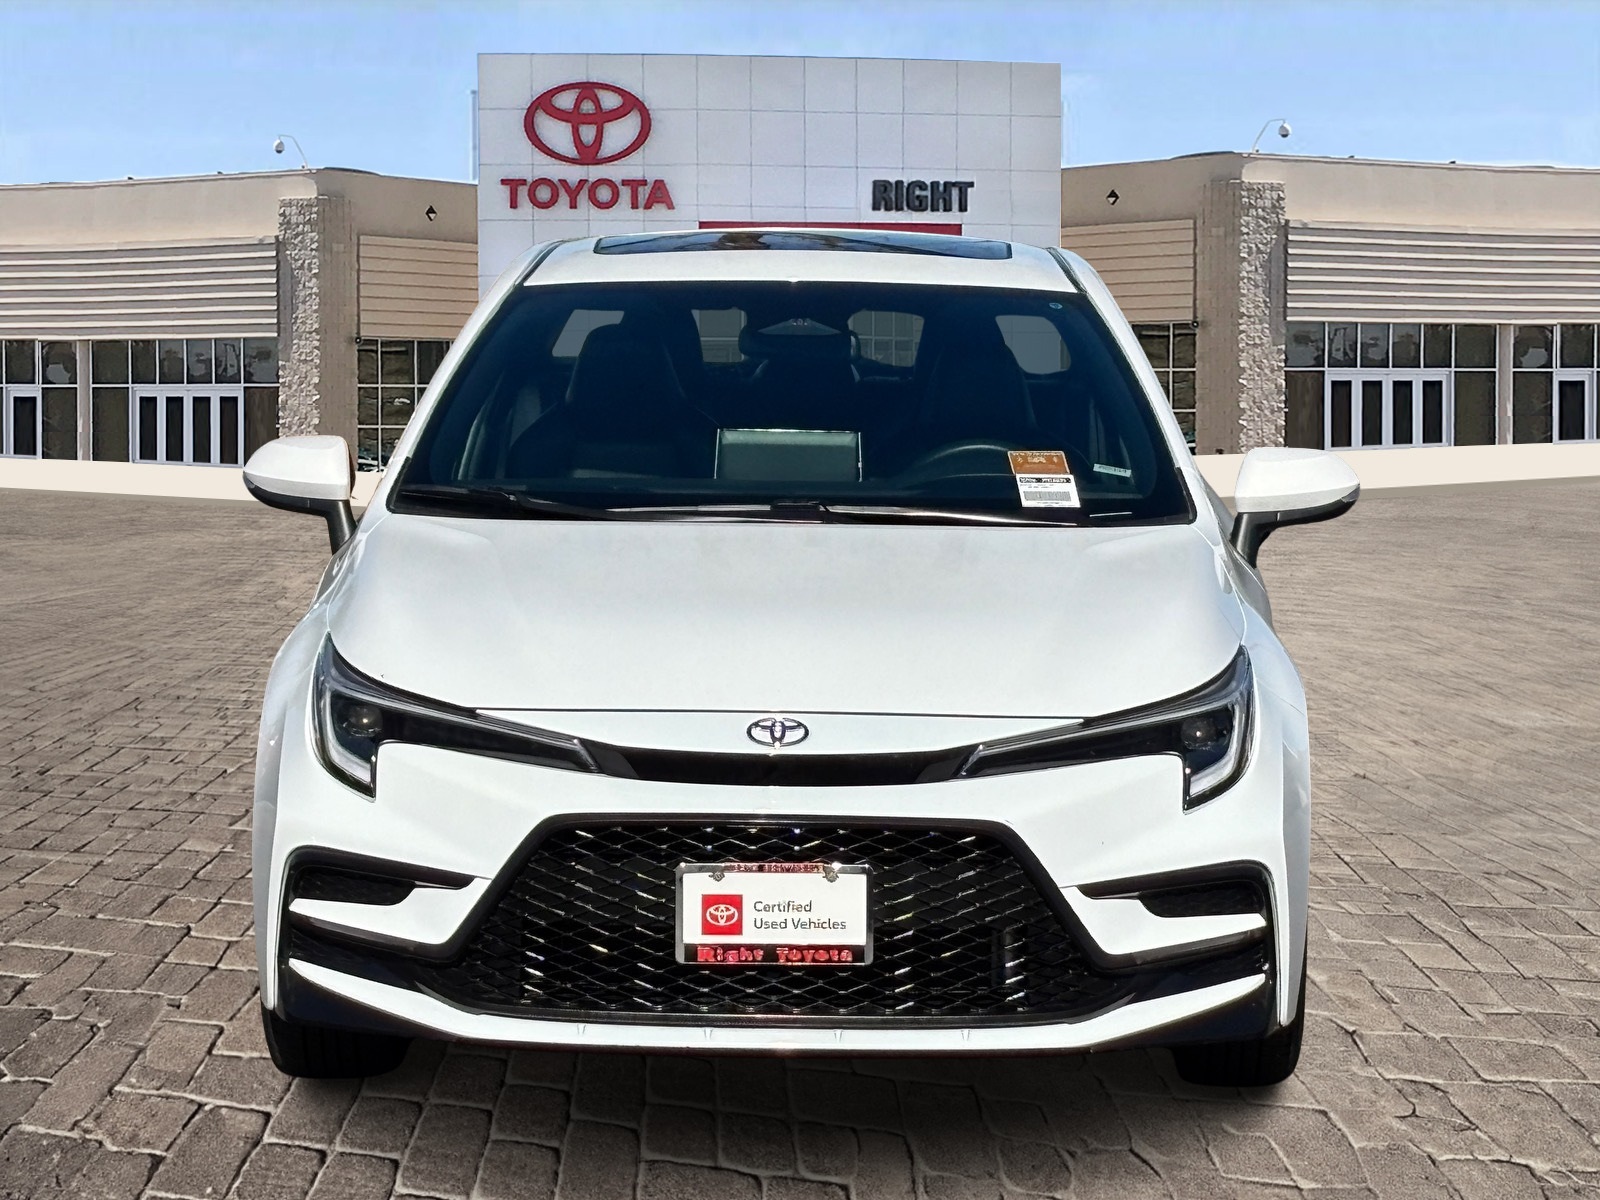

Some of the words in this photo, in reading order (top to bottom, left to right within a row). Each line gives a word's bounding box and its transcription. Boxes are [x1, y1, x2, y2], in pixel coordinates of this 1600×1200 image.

[501, 178, 674, 210] TOYOTA
[872, 180, 974, 212] RIGHT
[753, 900, 812, 913] Certified
[753, 917, 788, 930] Used
[791, 917, 847, 930] Vehicles
[697, 946, 764, 962] Right
[776, 947, 853, 963] Toyota
